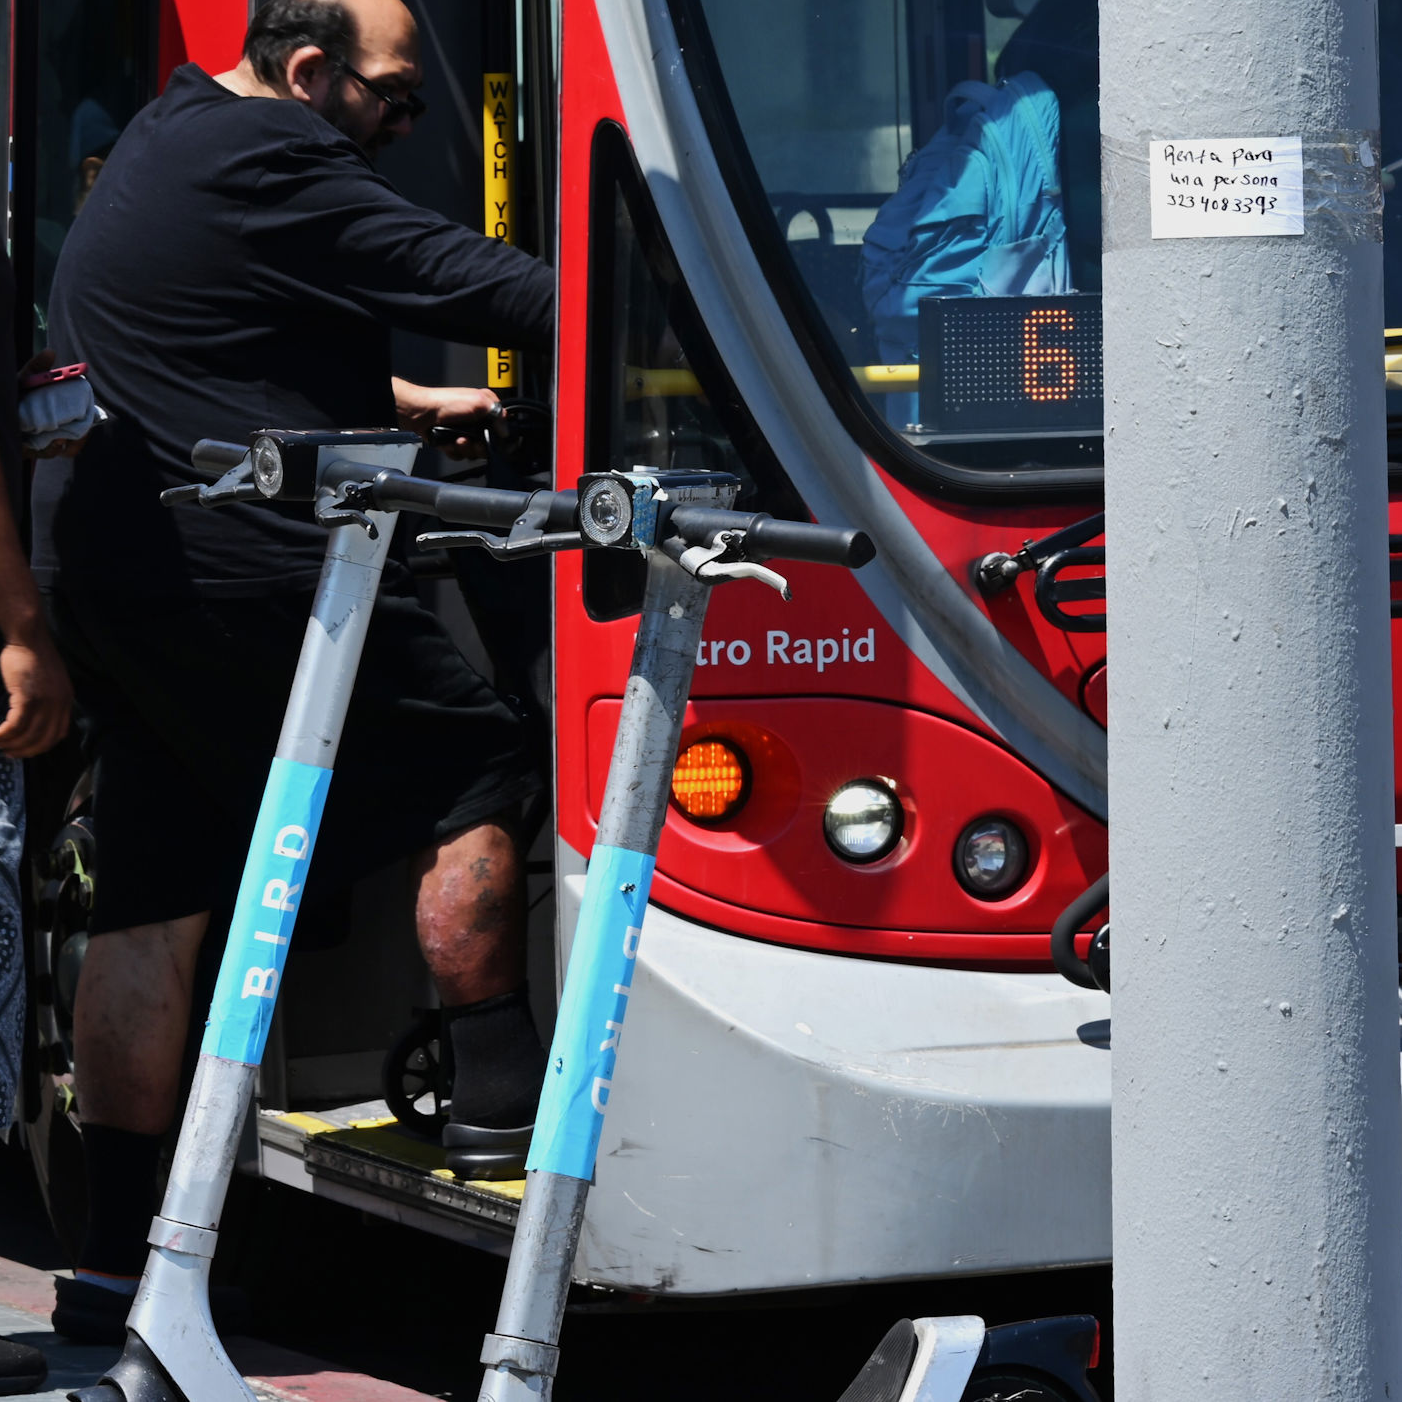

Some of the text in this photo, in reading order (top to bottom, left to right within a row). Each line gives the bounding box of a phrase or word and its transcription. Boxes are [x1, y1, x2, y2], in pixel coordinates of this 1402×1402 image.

[1164, 144, 1223, 166] Renta
[1171, 173, 1279, 191] una persona
[488, 80, 510, 380] WATCH YO EP
[1024, 309, 1075, 401] 6
[766, 627, 876, 673] Rapid
[240, 823, 310, 1001] BIRD
[591, 924, 643, 1116] BIRD
